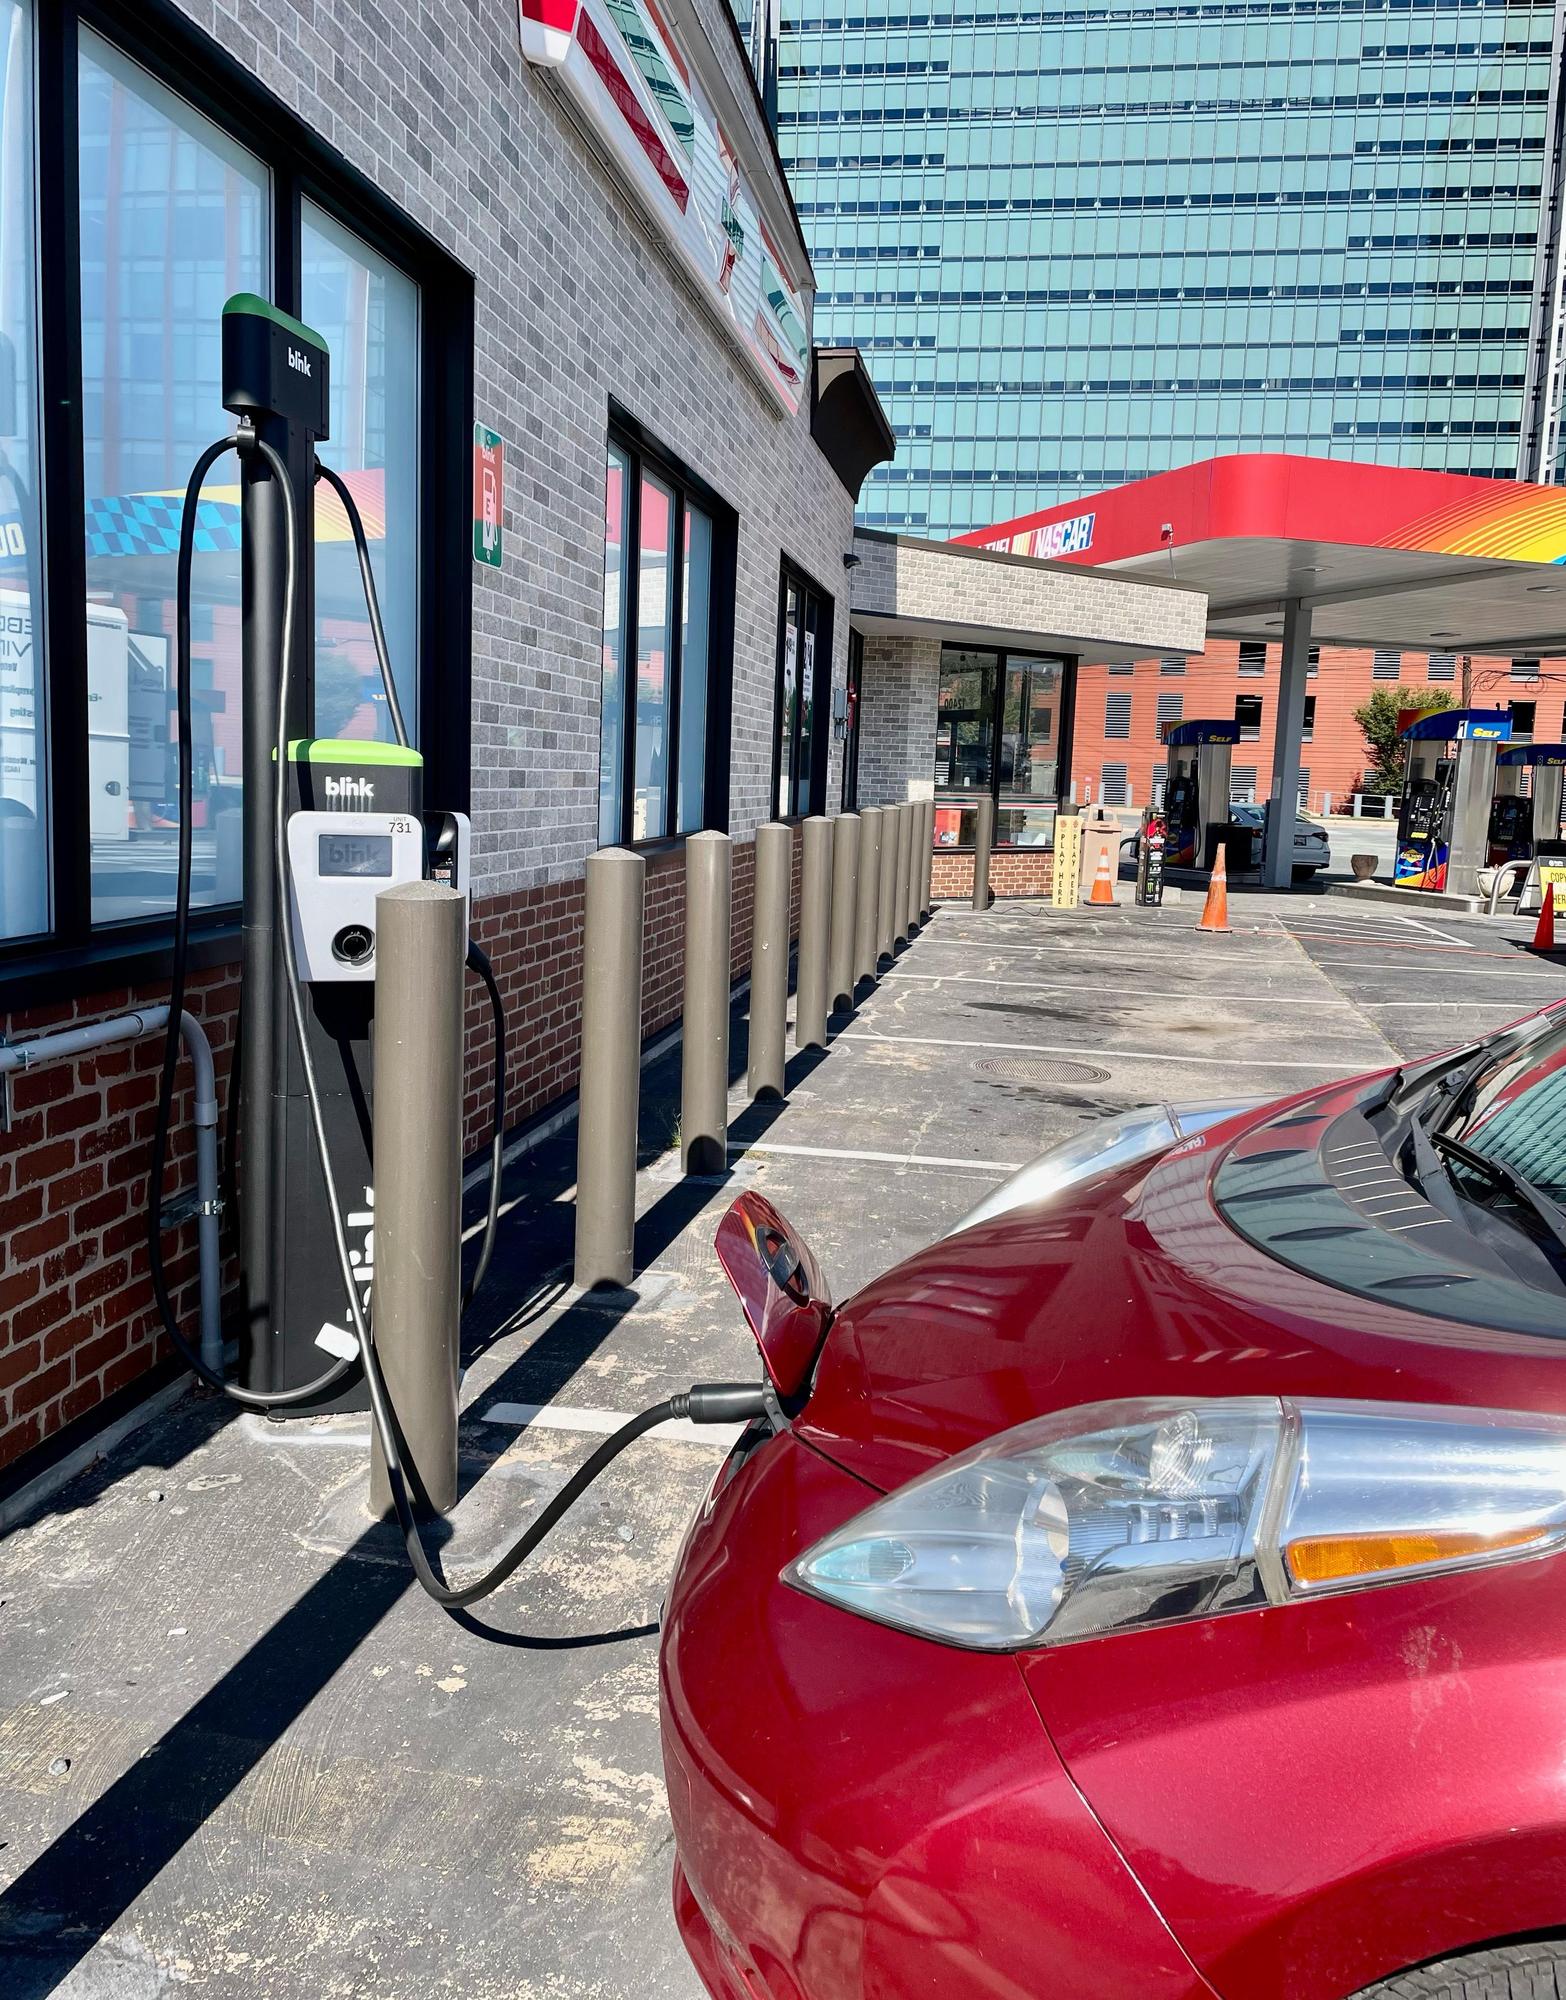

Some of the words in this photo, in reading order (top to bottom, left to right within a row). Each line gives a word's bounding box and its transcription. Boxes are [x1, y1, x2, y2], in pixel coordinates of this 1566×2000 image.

[288, 346, 312, 377] blink
[1035, 516, 1091, 558] NASCAR
[325, 776, 375, 797] blink
[388, 822, 412, 834] 731
[328, 843, 380, 864] blink
